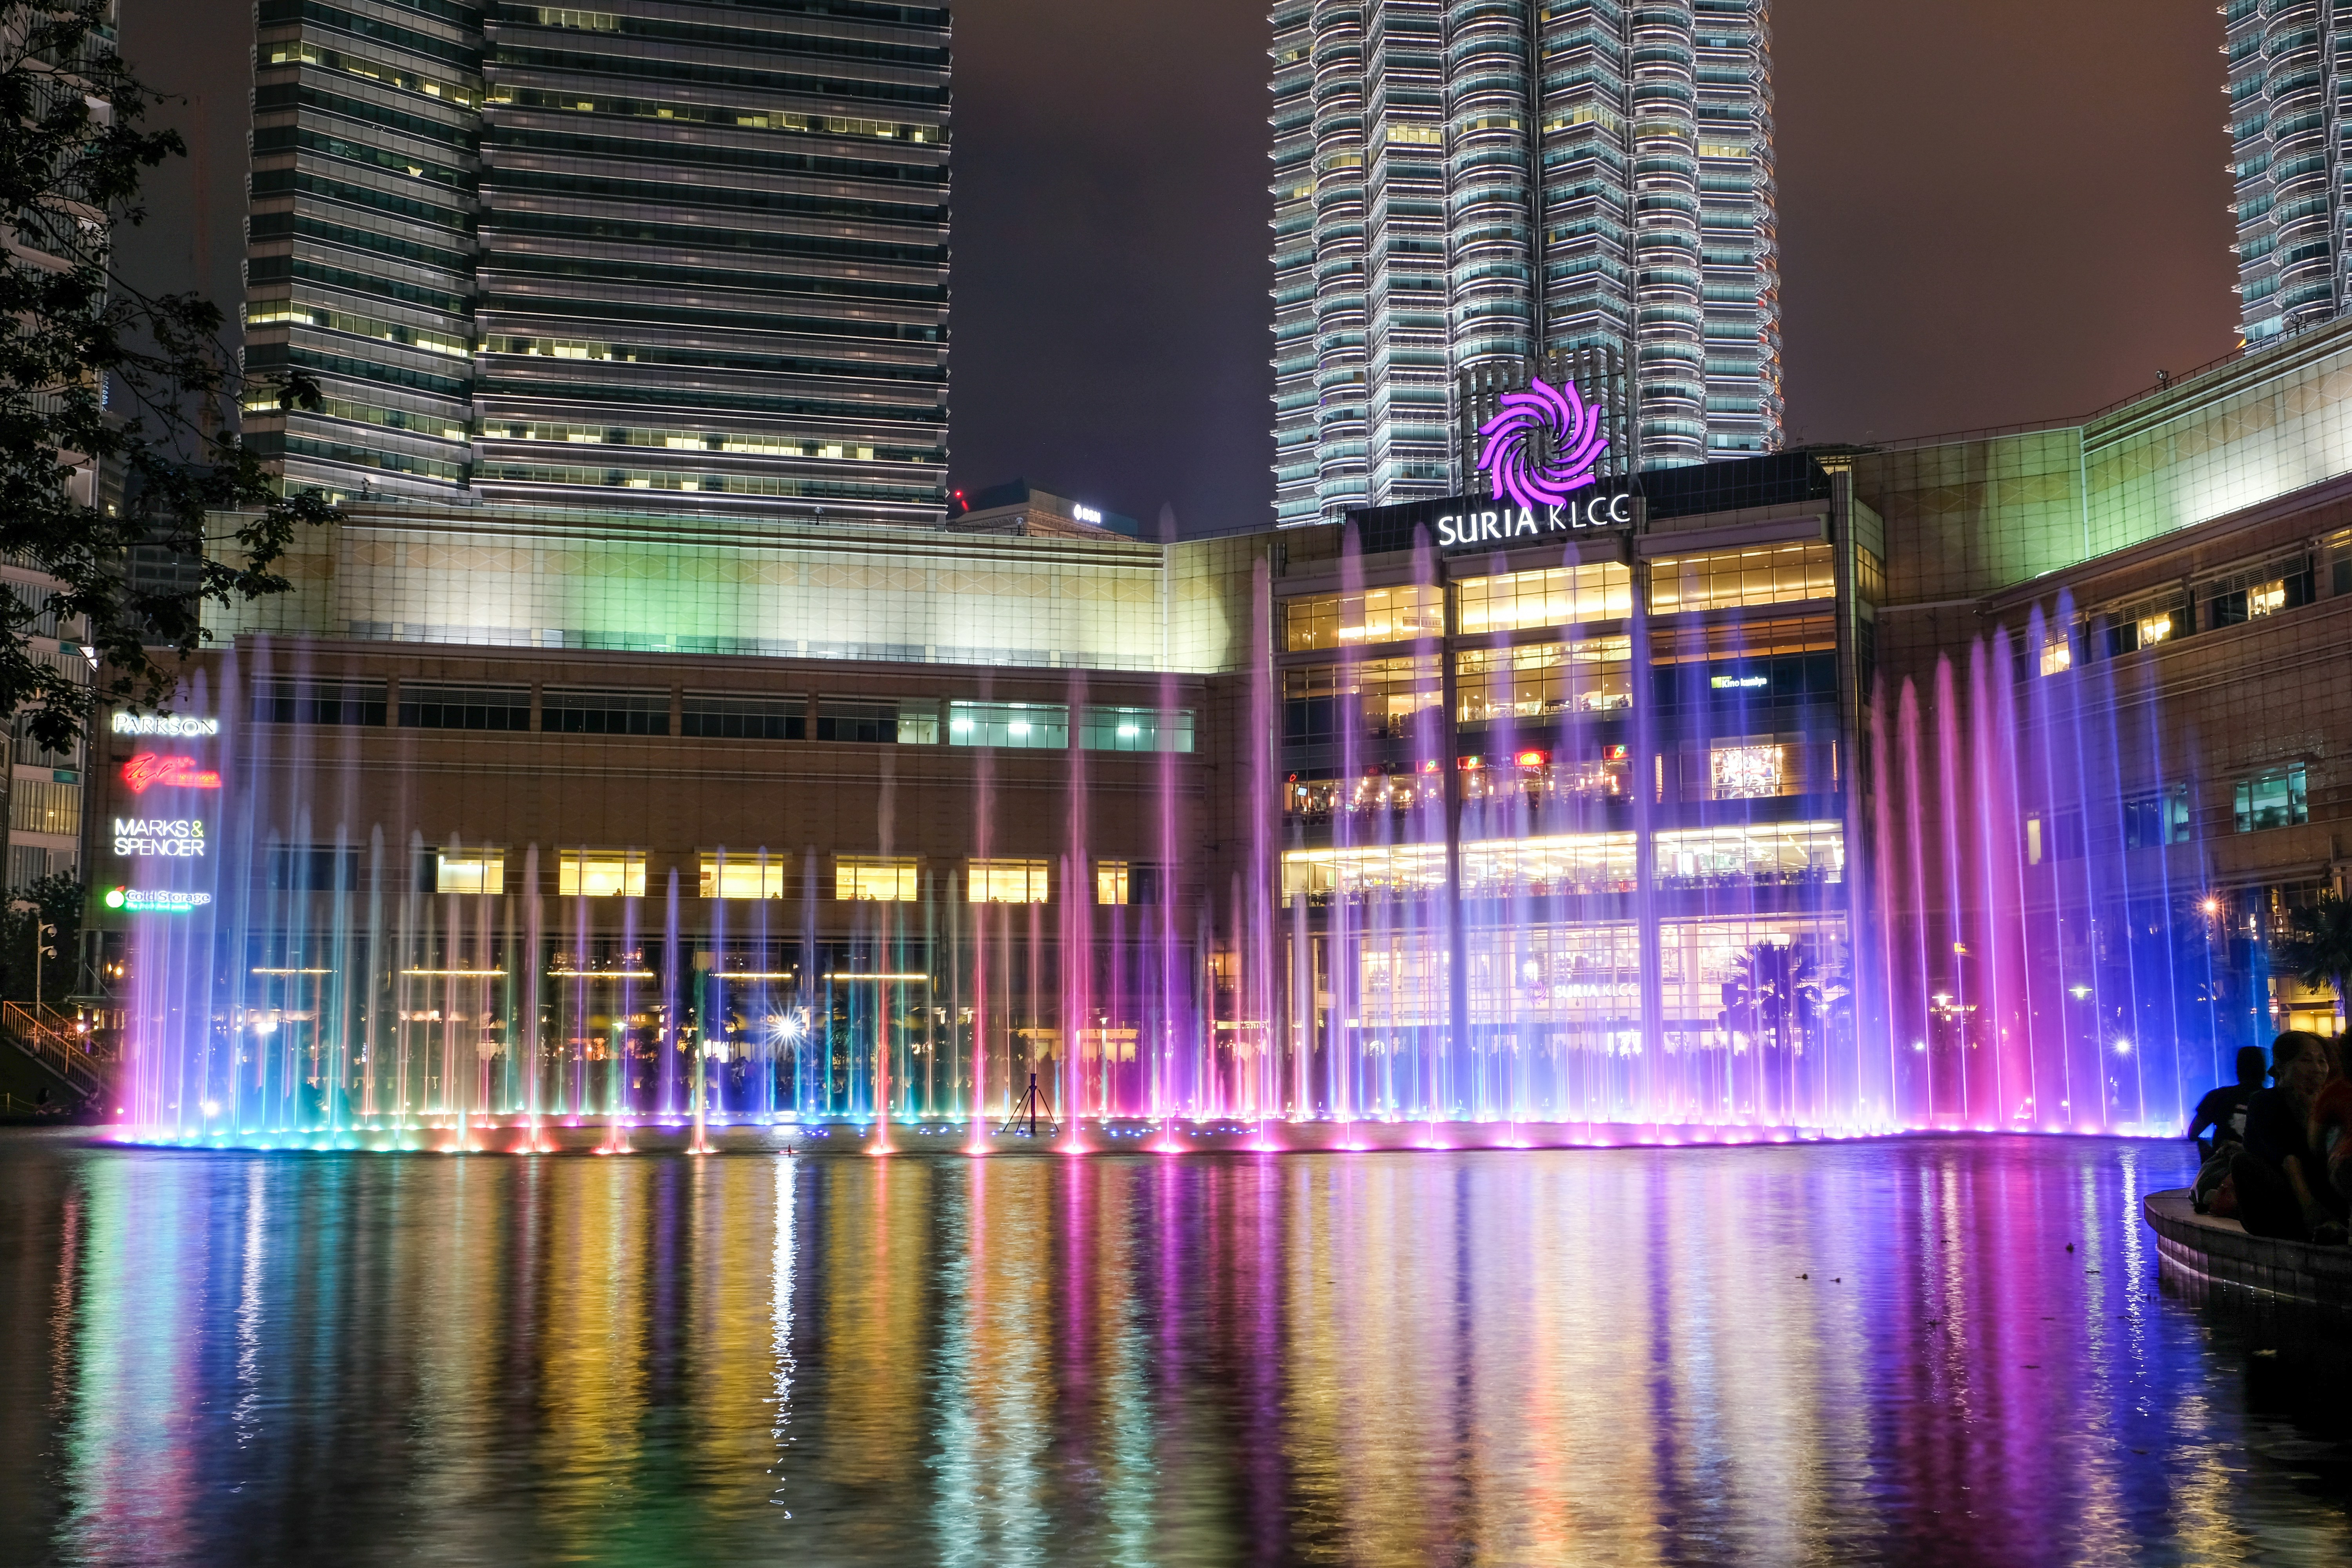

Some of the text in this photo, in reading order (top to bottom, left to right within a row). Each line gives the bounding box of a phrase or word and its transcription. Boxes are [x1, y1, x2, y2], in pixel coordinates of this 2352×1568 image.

[1083, 508, 1101, 523] BSN
[1438, 494, 1630, 545] SURIA KLCC
[115, 715, 216, 735] PARKSON
[115, 818, 205, 838] MARKS &
[114, 837, 205, 857] SPENCER
[127, 891, 211, 904] Cold Storage
[1554, 984, 1637, 998] SURIA KLCC
